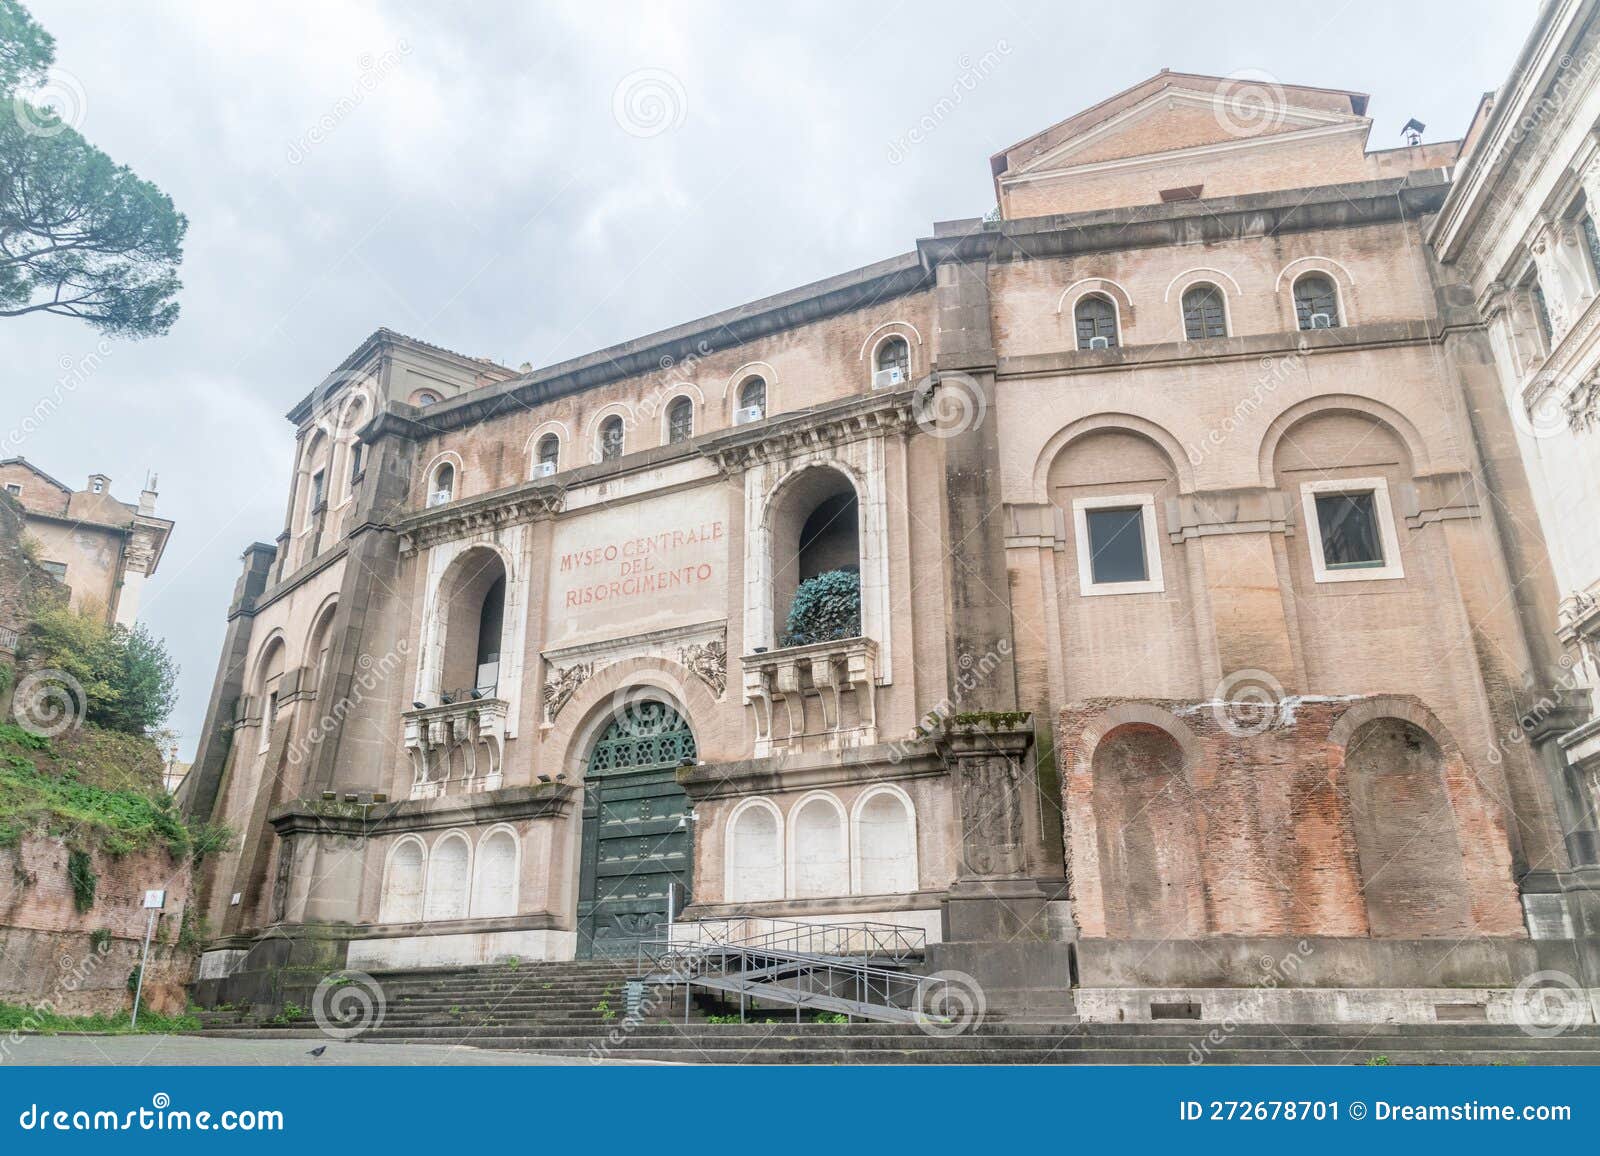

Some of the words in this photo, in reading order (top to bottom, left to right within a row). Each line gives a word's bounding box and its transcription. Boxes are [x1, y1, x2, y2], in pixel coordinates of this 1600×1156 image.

[560, 545, 618, 571] MVSEO
[622, 521, 724, 557] CENTRALE
[620, 557, 655, 576] DEL
[566, 563, 712, 608] RISORGIMENTO
